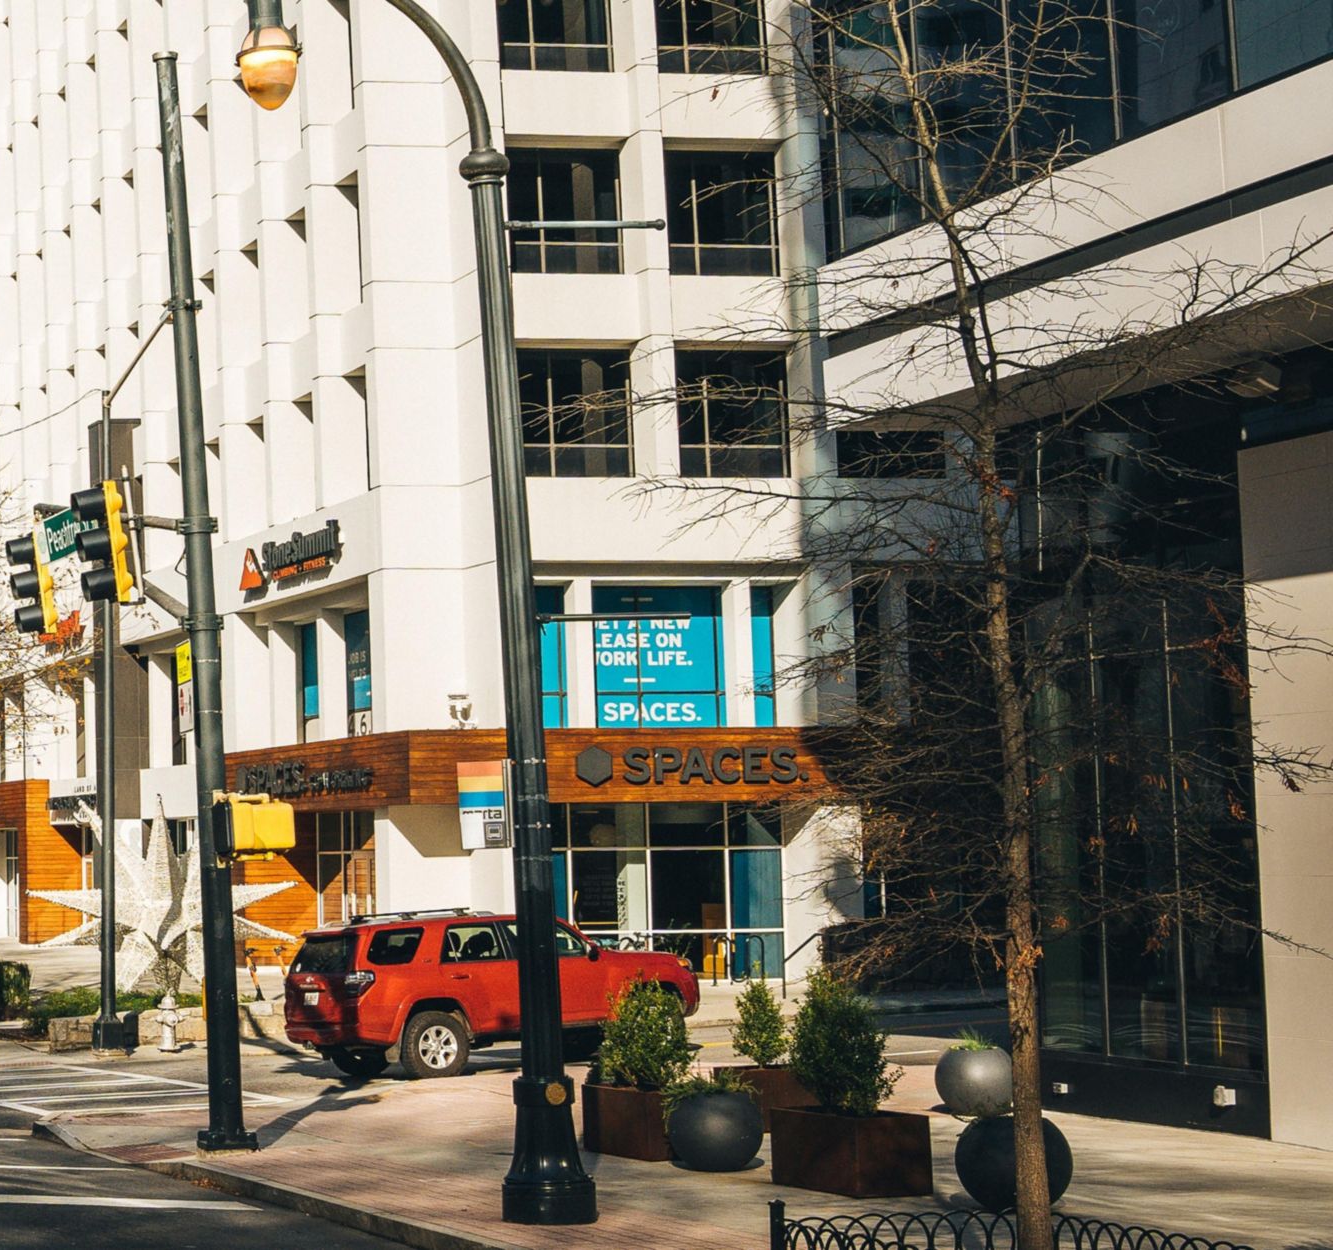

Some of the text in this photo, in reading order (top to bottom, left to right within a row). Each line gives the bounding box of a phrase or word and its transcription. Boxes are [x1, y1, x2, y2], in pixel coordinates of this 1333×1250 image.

[303, 556, 326, 571] FITNESS
[595, 619, 620, 630] ET
[650, 618, 692, 630] NEW
[655, 632, 683, 648] ON
[595, 650, 693, 666] ORK LIFE.
[603, 702, 702, 722] SPACES.
[622, 746, 810, 785] SPACES.
